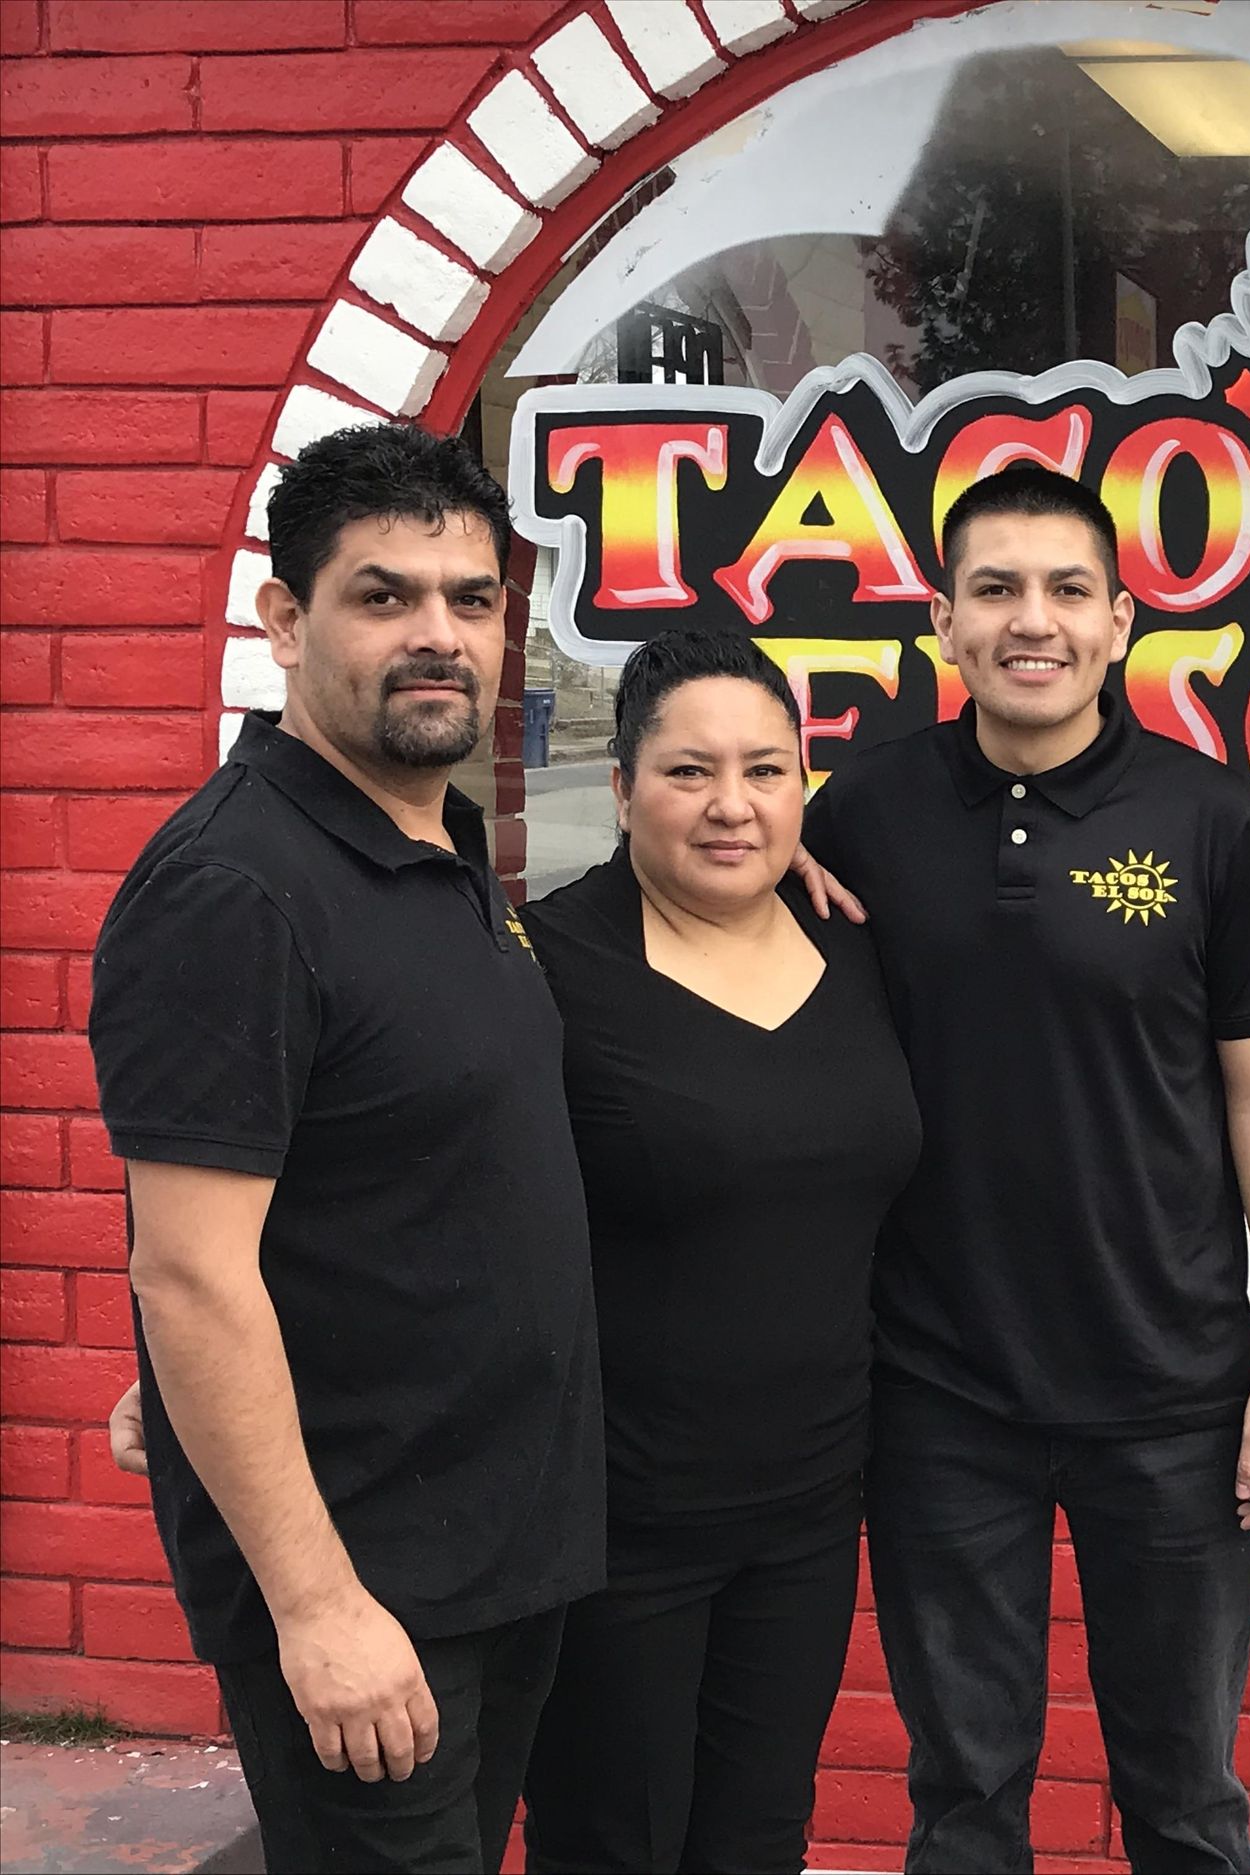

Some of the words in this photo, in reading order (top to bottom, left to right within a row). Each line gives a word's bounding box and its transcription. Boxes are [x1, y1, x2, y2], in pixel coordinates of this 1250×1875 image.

[1069, 870, 1149, 887] TACOS
[1091, 884, 1123, 898] EL
[1127, 886, 1168, 903] SOL
